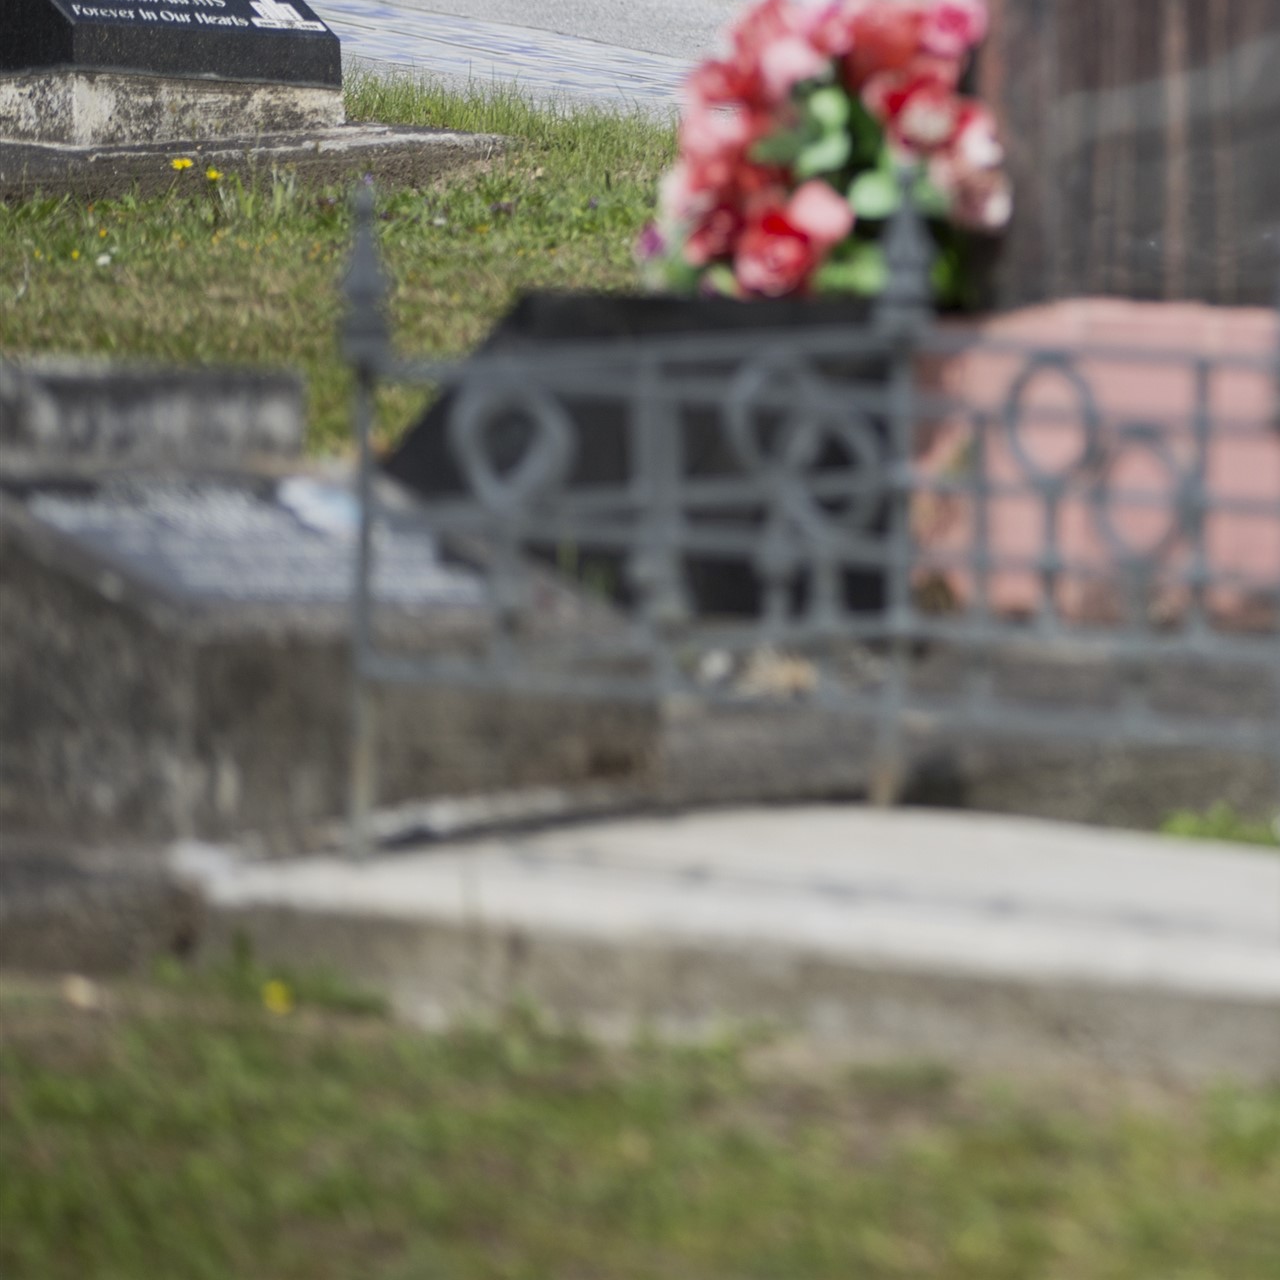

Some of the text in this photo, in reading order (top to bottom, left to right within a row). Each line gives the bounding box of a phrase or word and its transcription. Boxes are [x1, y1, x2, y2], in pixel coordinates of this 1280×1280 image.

[71, 4, 249, 28] Forever In Our Hearts
